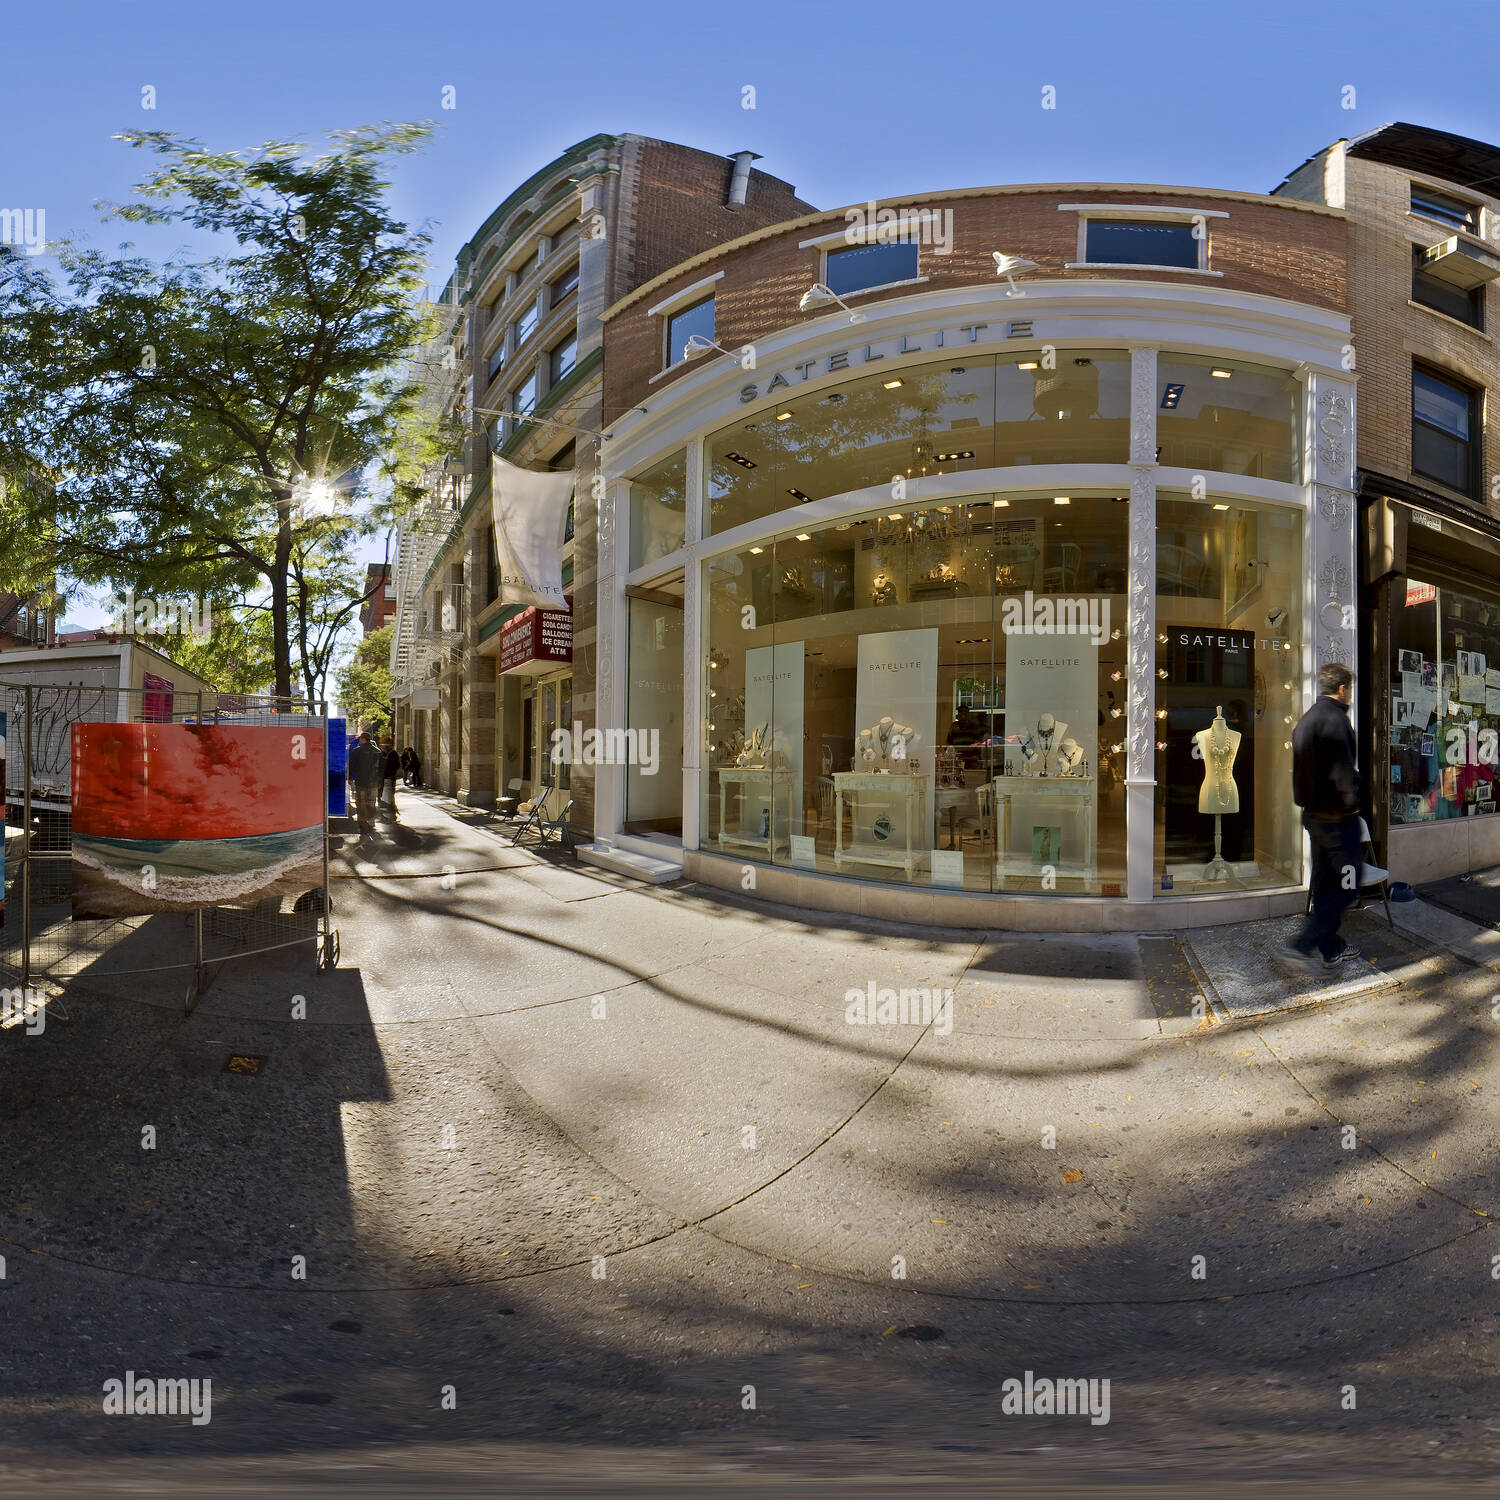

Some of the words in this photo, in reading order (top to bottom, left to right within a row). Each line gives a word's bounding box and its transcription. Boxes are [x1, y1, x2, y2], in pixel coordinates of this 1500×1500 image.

[740, 320, 1034, 403] SATELLITE
[543, 621, 557, 629] SODA
[542, 629, 573, 639] BALLOONS
[1180, 634, 1281, 651] SATELLITE
[550, 647, 567, 655] ATM
[869, 662, 921, 671] SATELLITE
